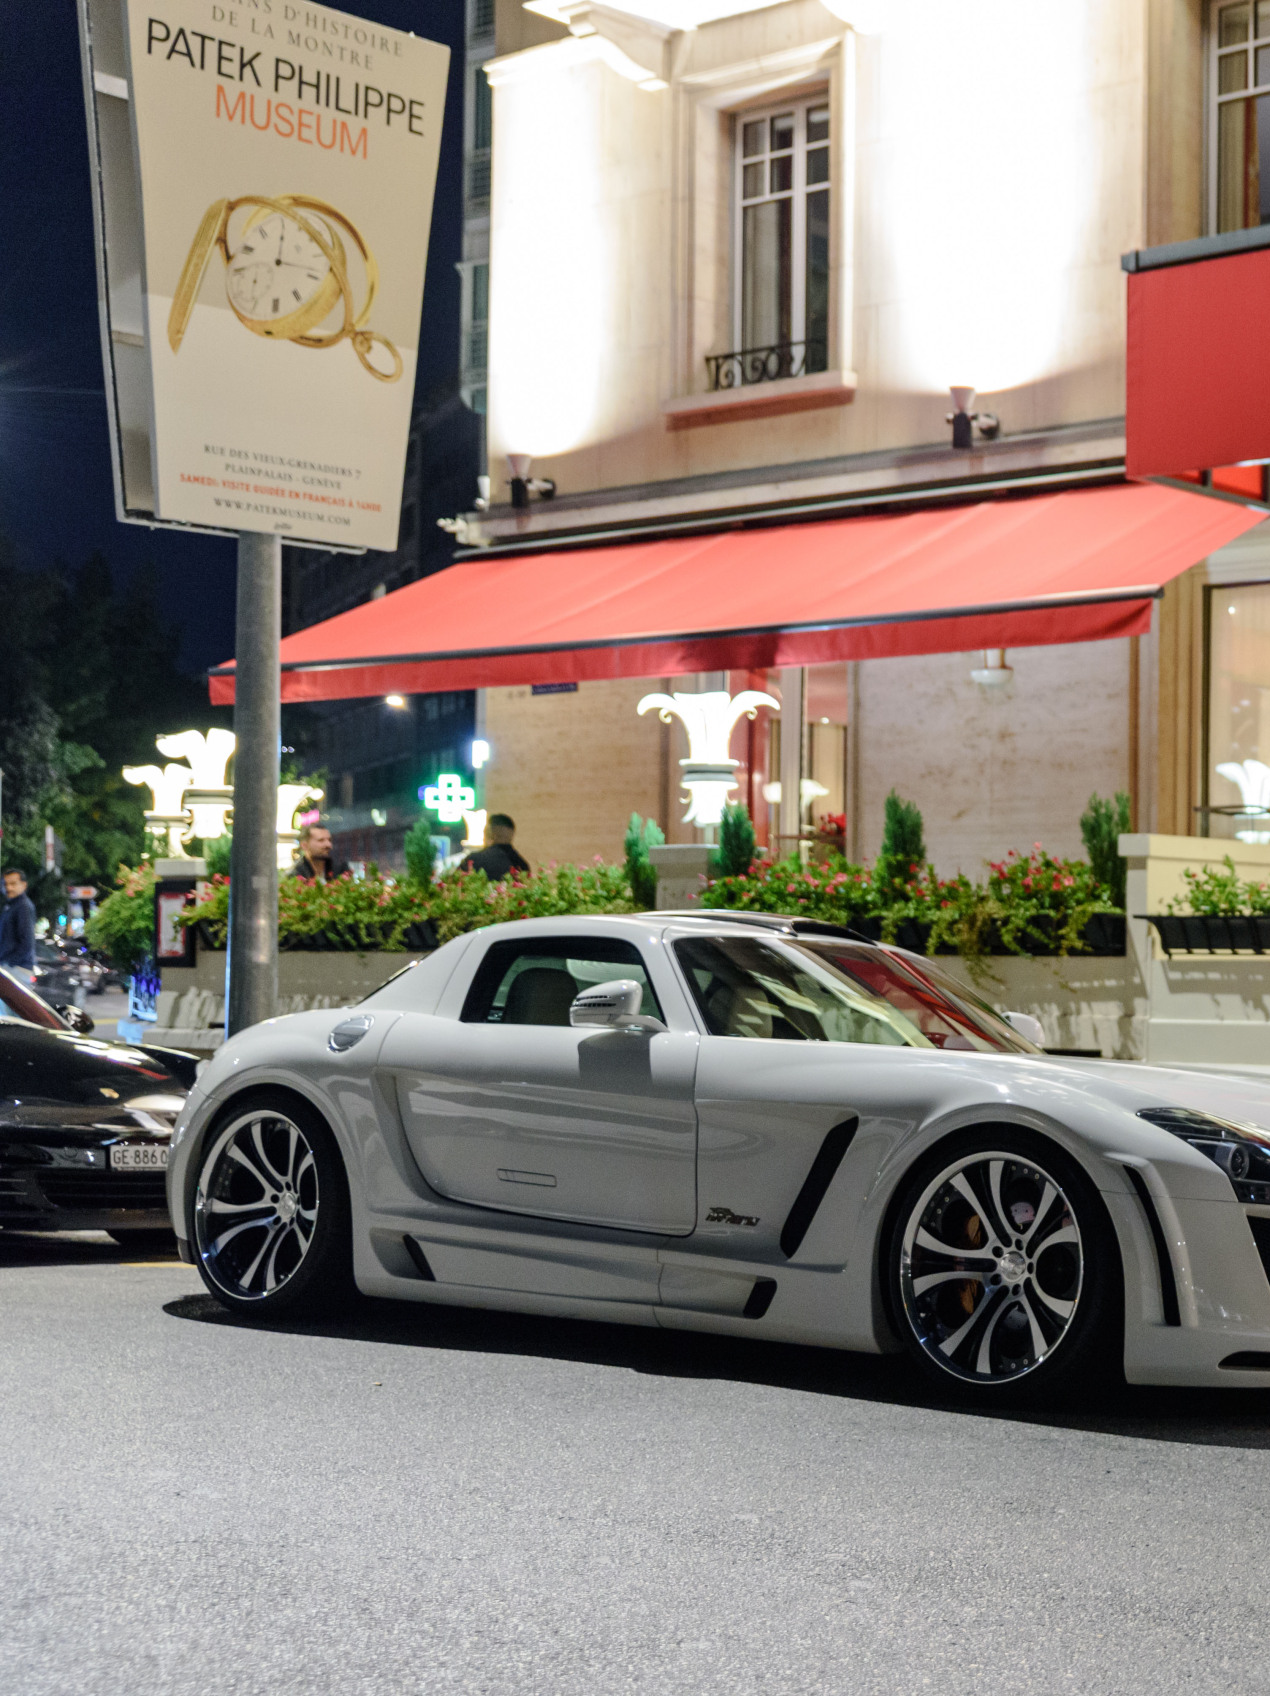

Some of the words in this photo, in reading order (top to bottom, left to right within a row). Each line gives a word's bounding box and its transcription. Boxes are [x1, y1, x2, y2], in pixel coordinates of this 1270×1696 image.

[212, 5, 238, 27] DE
[251, 18, 275, 40] LA
[288, 30, 373, 70] MONTRE
[284, 5, 402, 58] D'HISTOIRE
[147, 18, 262, 88] PATEK
[274, 57, 425, 136] PHILIPPE
[215, 84, 369, 160] MUSEUM
[204, 444, 225, 456] RUE
[229, 448, 250, 460] DES
[225, 463, 293, 482] PLAINPALAIS
[222, 480, 250, 493] VISITE
[288, 489, 300, 499] EN
[302, 491, 346, 507] FRANÇAIS
